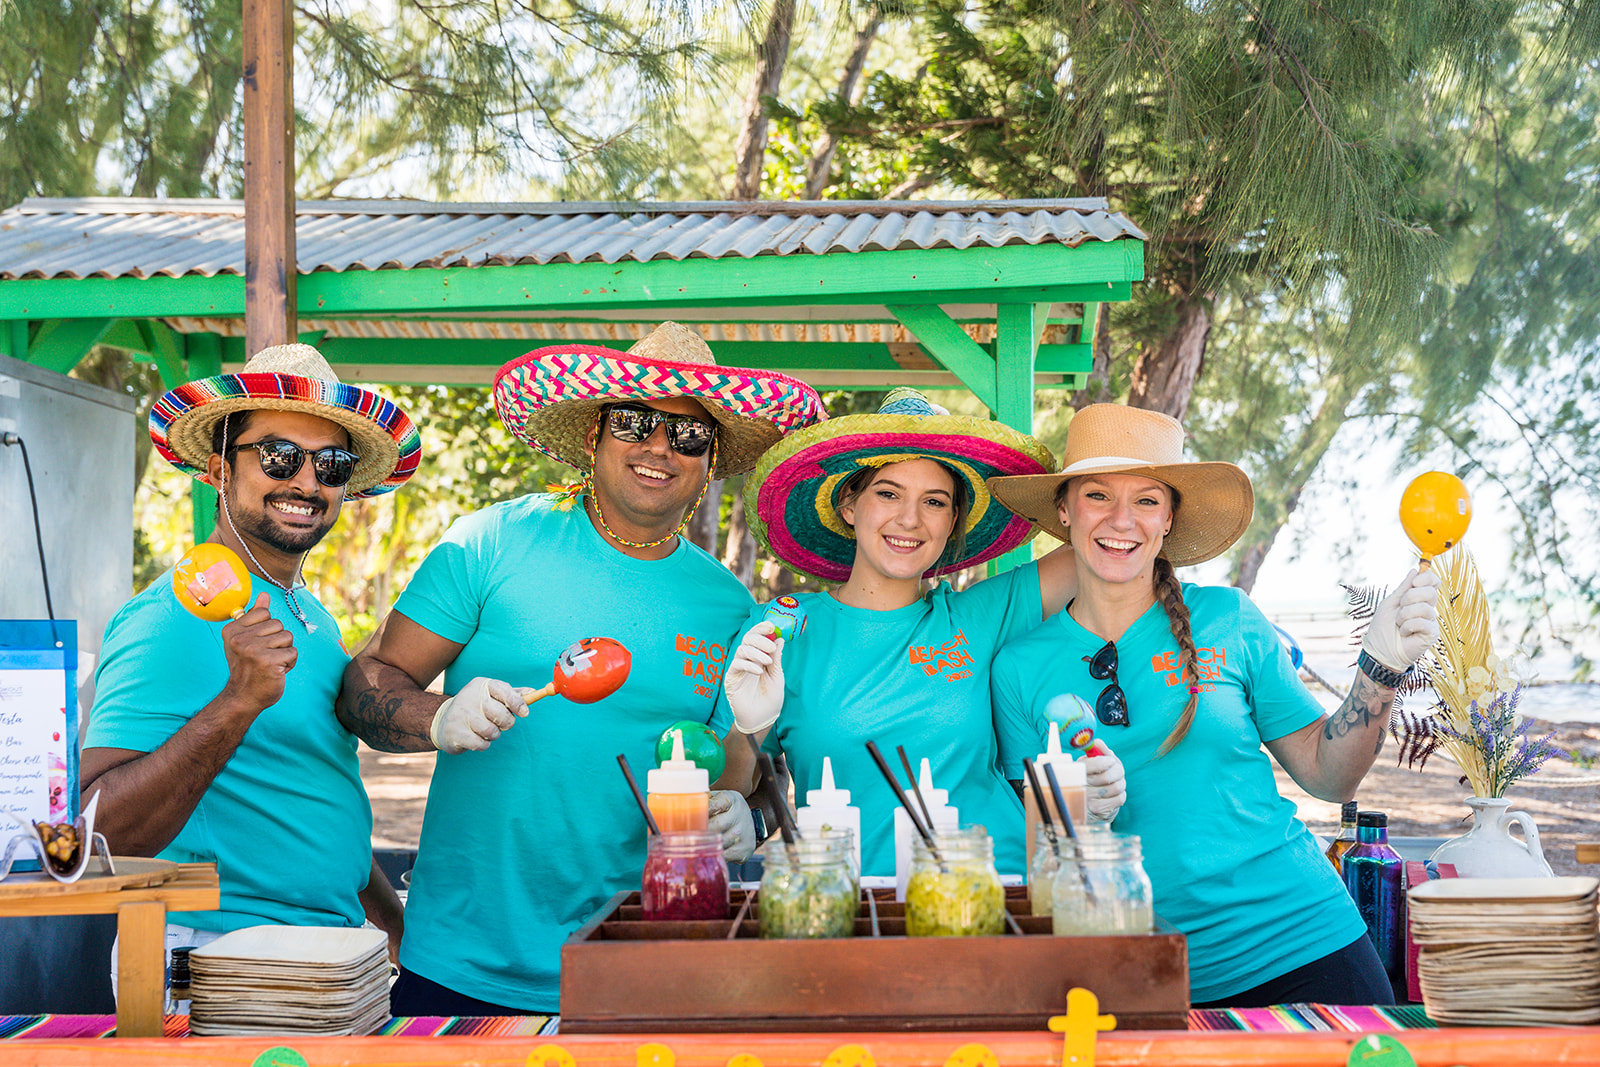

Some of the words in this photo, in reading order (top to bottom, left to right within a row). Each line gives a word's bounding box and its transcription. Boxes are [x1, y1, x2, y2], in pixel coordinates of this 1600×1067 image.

[909, 628, 969, 664] BEACH
[682, 657, 724, 687] BASH
[921, 649, 975, 677] BASH
[944, 669, 973, 682] 2023
[694, 683, 713, 699] 2023
